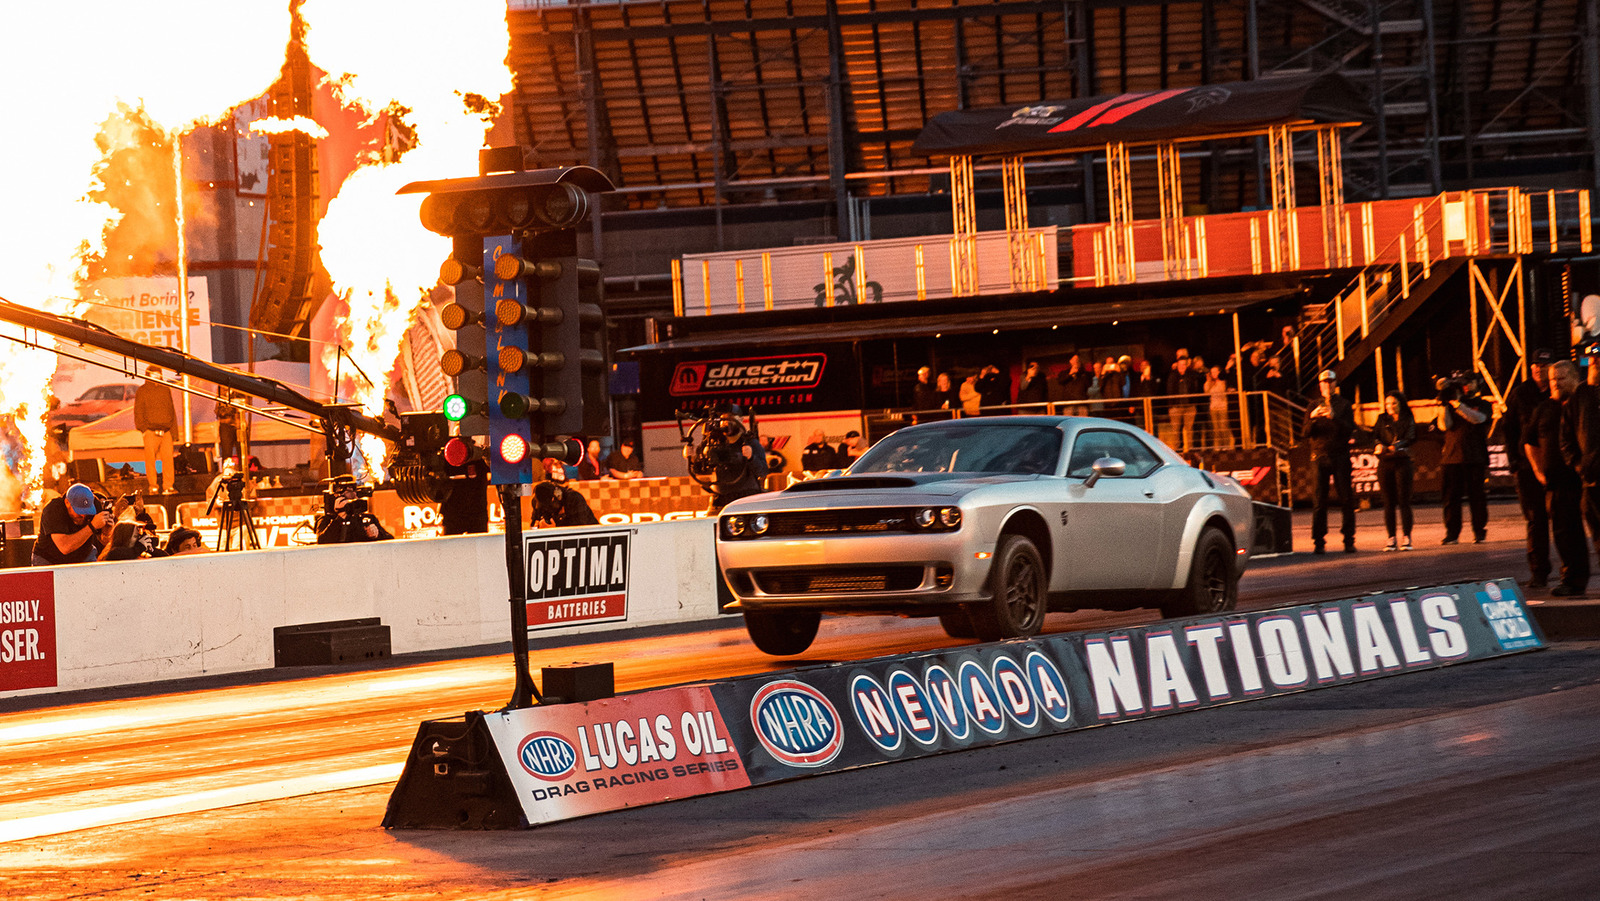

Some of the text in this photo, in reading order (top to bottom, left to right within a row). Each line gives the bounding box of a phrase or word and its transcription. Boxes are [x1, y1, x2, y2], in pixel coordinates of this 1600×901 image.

[705, 371, 819, 389] connection
[708, 361, 801, 379] direct
[530, 543, 625, 593] OPTIMA
[0, 599, 44, 624] SIBLY.
[548, 600, 607, 620] BATTERIES
[0, 628, 45, 663] SER.
[1084, 592, 1469, 719] NATIONALS
[857, 664, 1067, 738] NEVADA
[577, 711, 728, 772] LUCAS OIL
[762, 694, 833, 752] NHRA
[522, 737, 576, 776] NHRA
[531, 759, 739, 802] DRAG RACING SERIES
